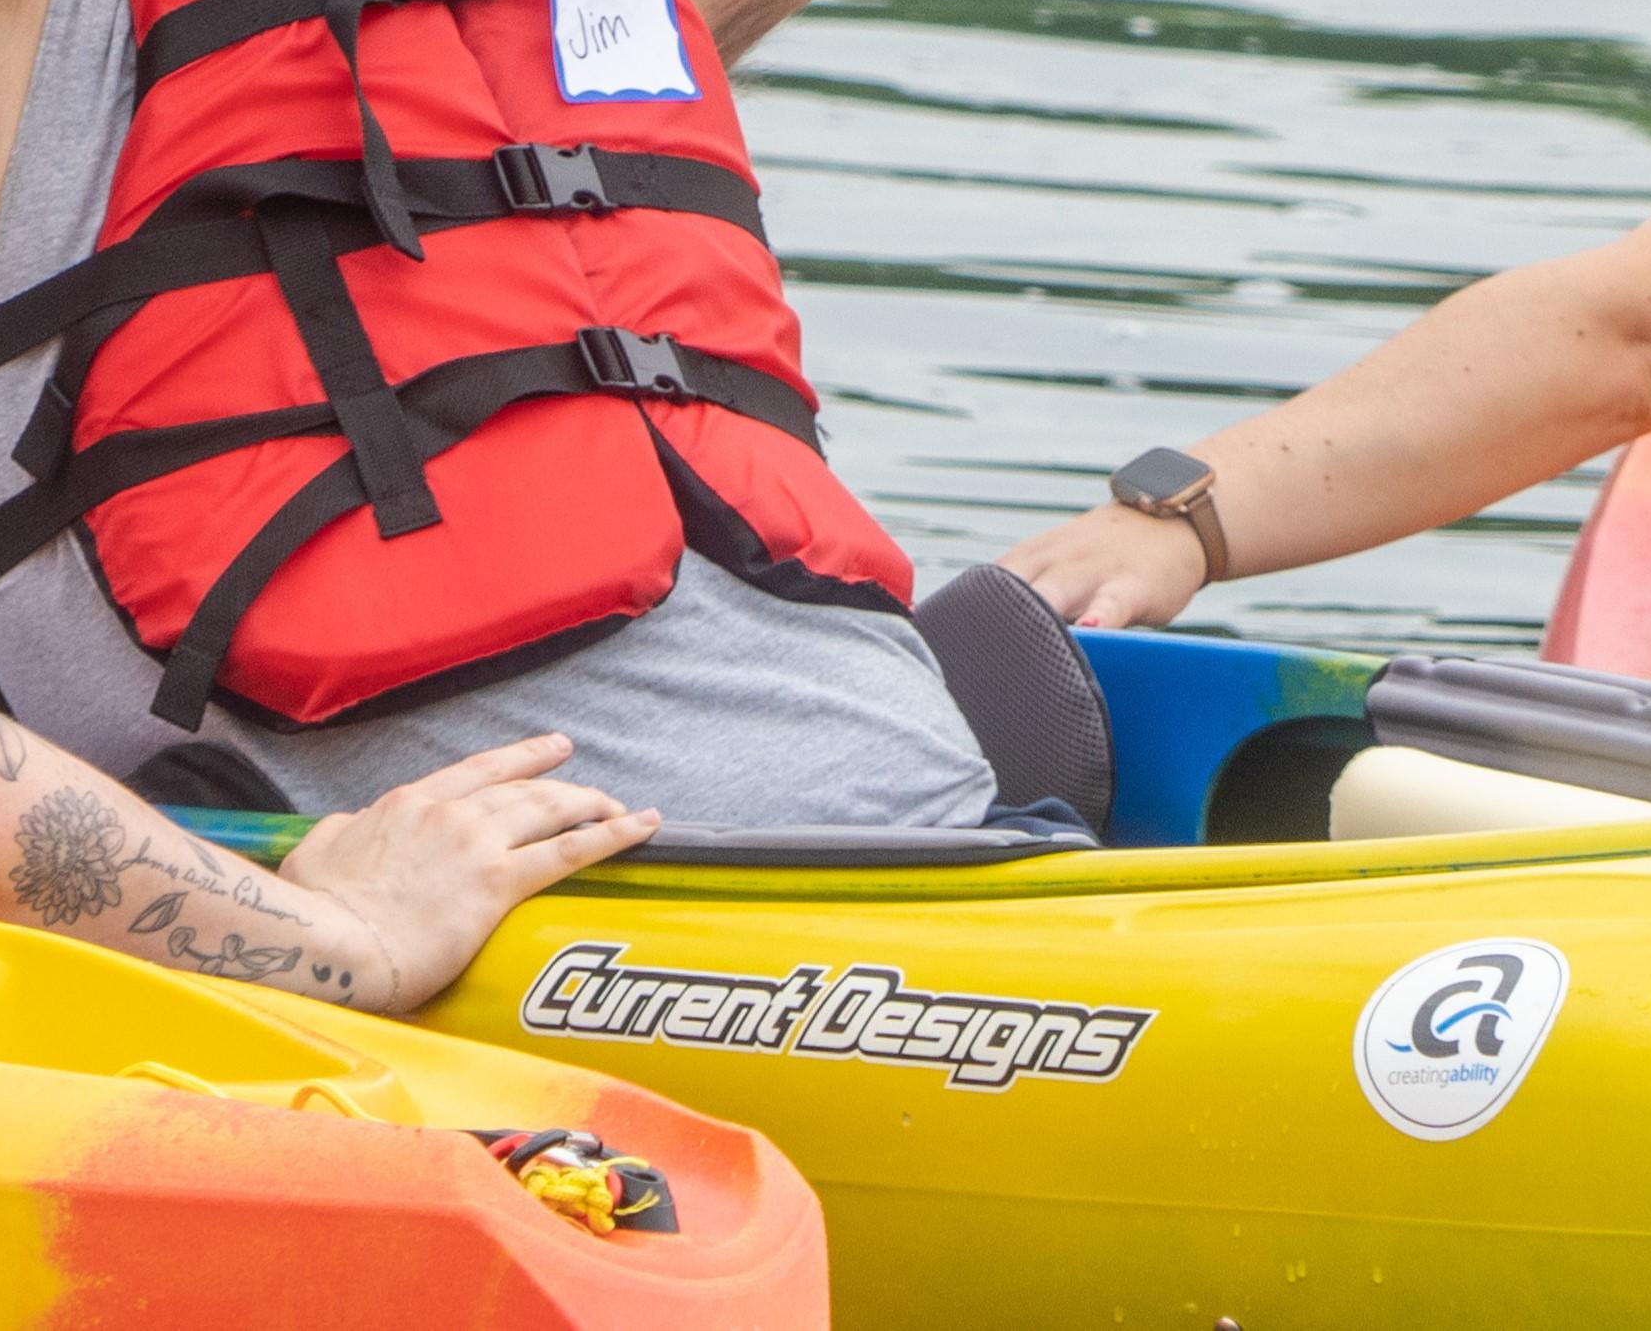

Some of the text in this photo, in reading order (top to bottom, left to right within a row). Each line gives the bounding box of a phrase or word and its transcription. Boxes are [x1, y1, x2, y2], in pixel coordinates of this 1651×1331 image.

[568, 6, 631, 60] Jim
[521, 942, 1156, 1087] Current Designs
